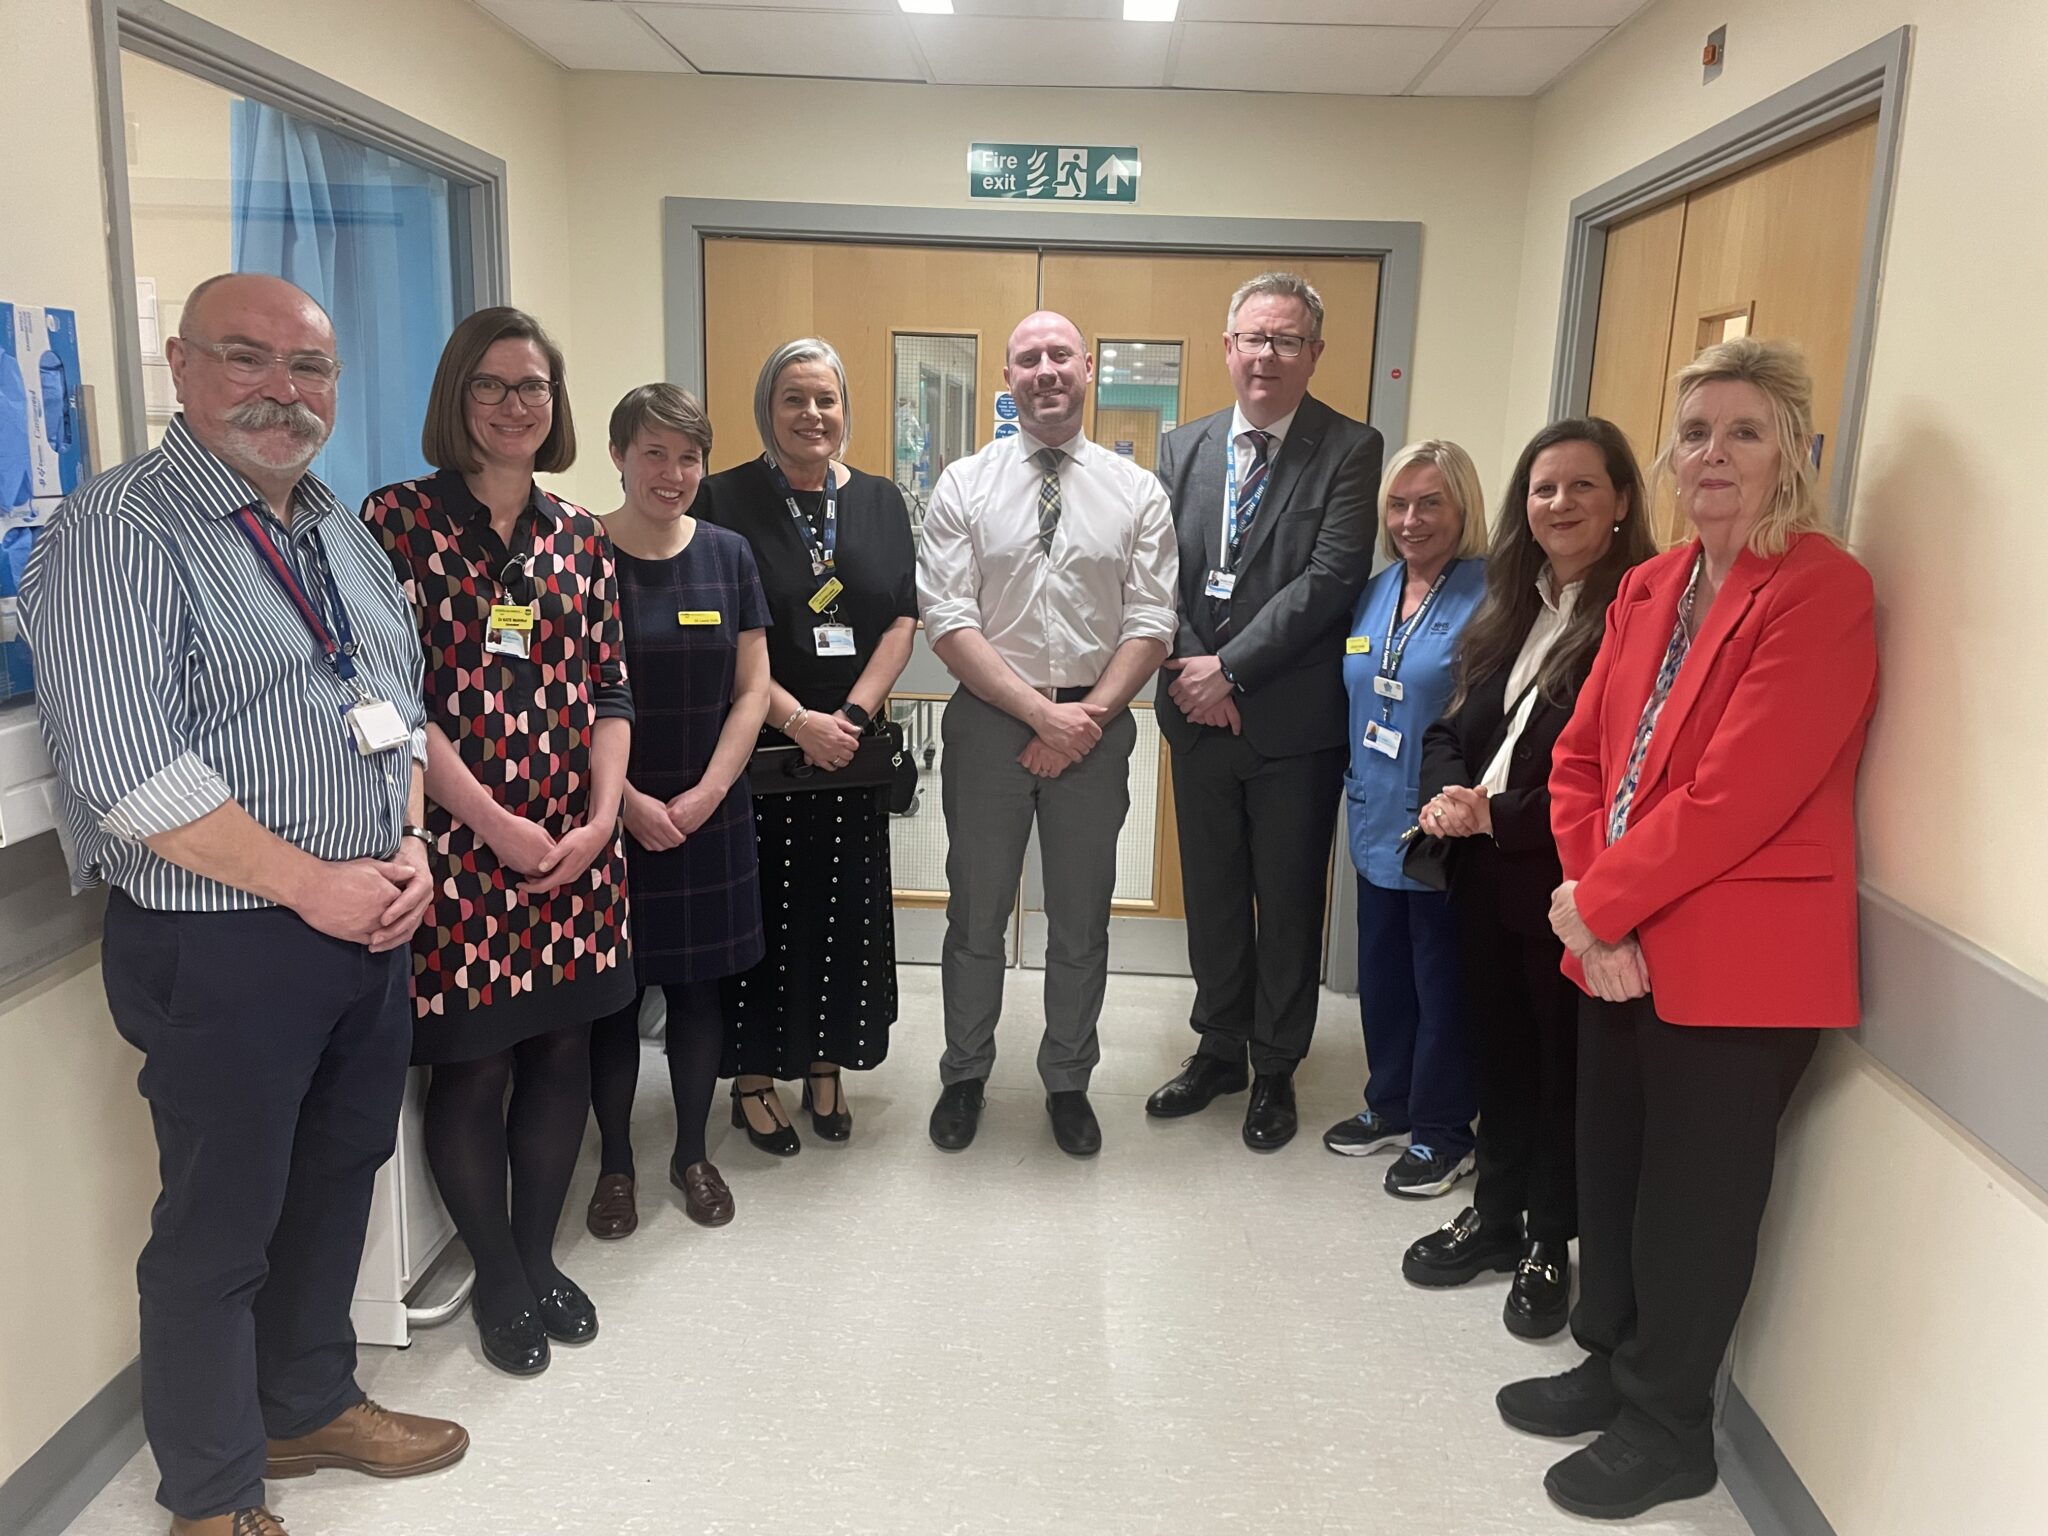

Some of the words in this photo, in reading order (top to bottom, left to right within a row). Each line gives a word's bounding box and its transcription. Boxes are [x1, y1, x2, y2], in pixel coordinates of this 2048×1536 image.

[982, 152, 1018, 168] Fire
[982, 174, 1016, 190] exit
[1254, 485, 1264, 499] NHS
[1245, 502, 1256, 517] NHS
[1424, 593, 1433, 605] care
